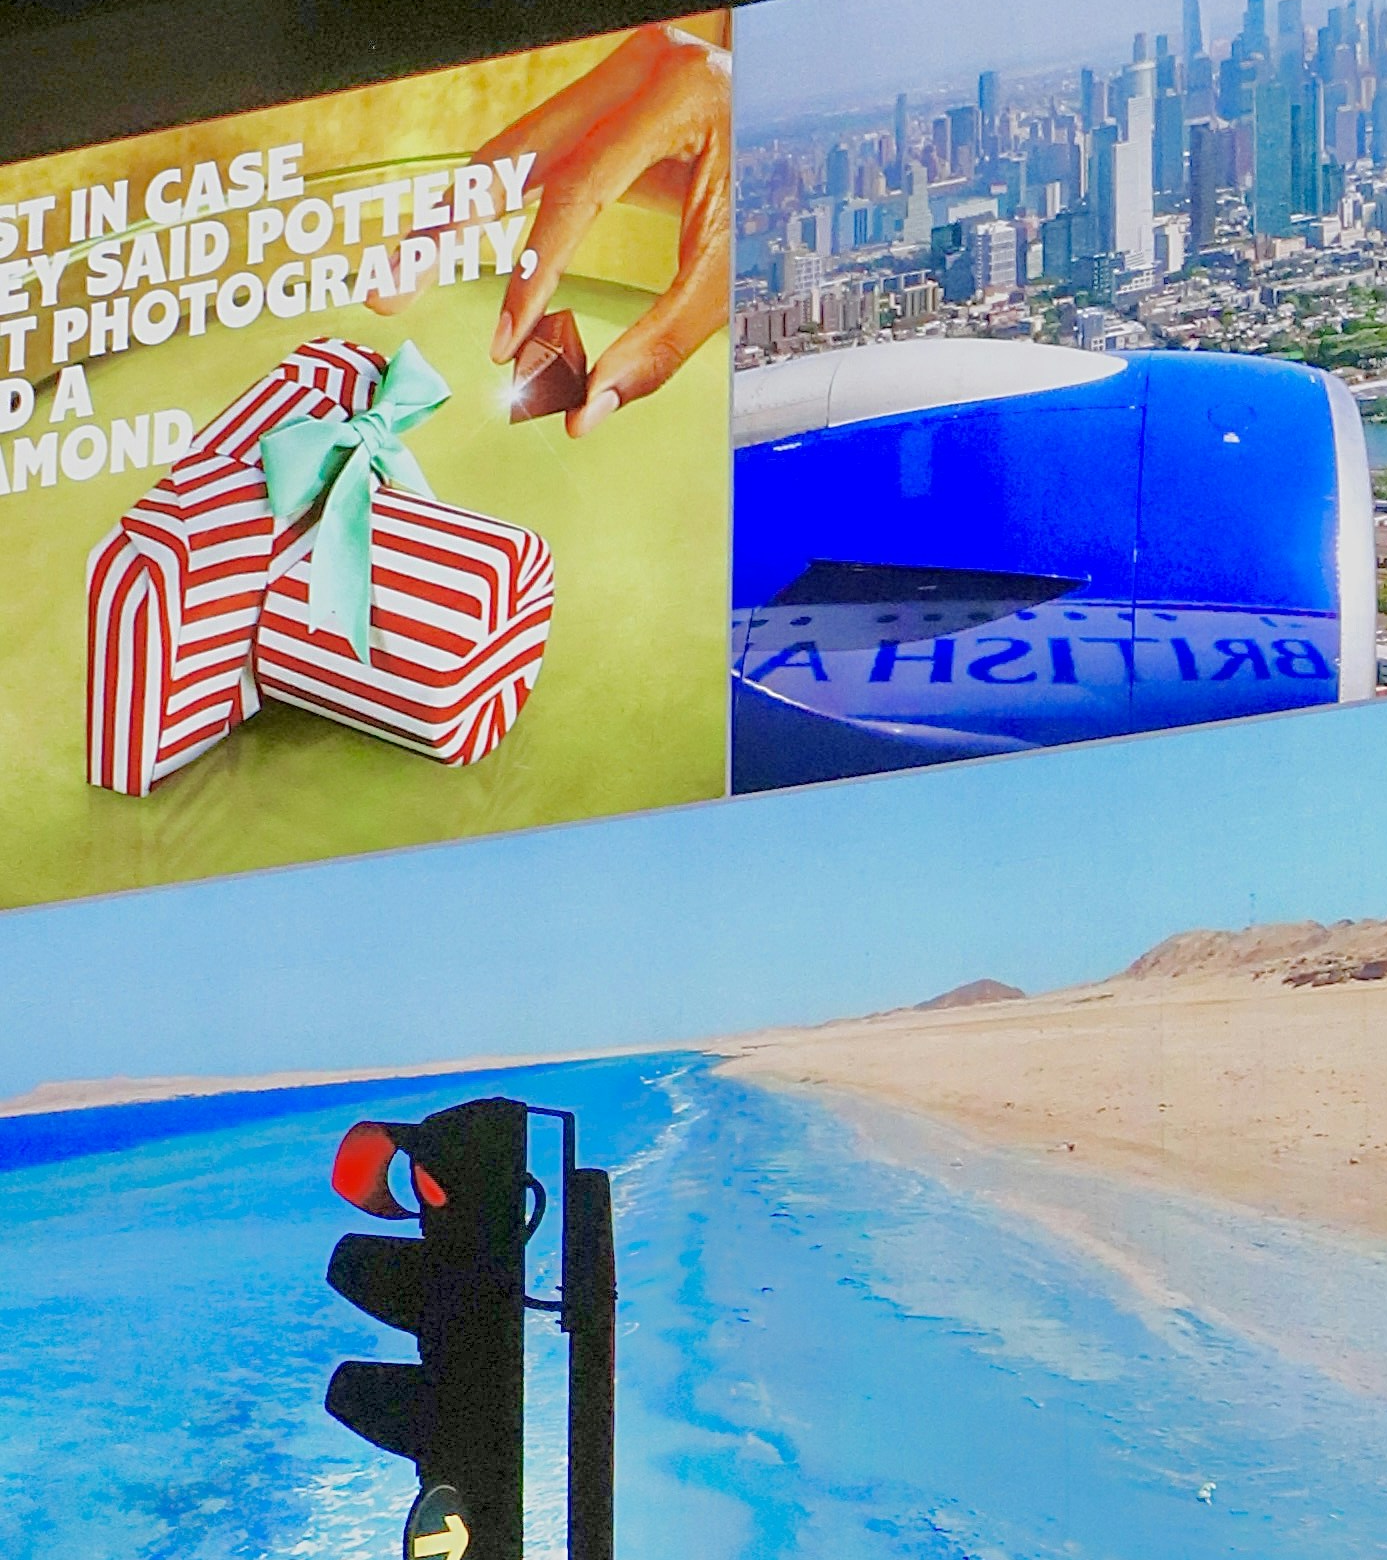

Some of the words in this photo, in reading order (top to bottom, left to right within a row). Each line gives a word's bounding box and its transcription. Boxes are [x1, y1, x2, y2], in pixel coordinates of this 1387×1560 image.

[70, 180, 129, 242] IN
[145, 142, 304, 225] CASE
[87, 220, 230, 297] SAID
[247, 152, 537, 265] POTTERY
[52, 215, 539, 364] PHOTOGRAPHY,
[50, 364, 94, 423] A
[0, 408, 194, 493] MOND
